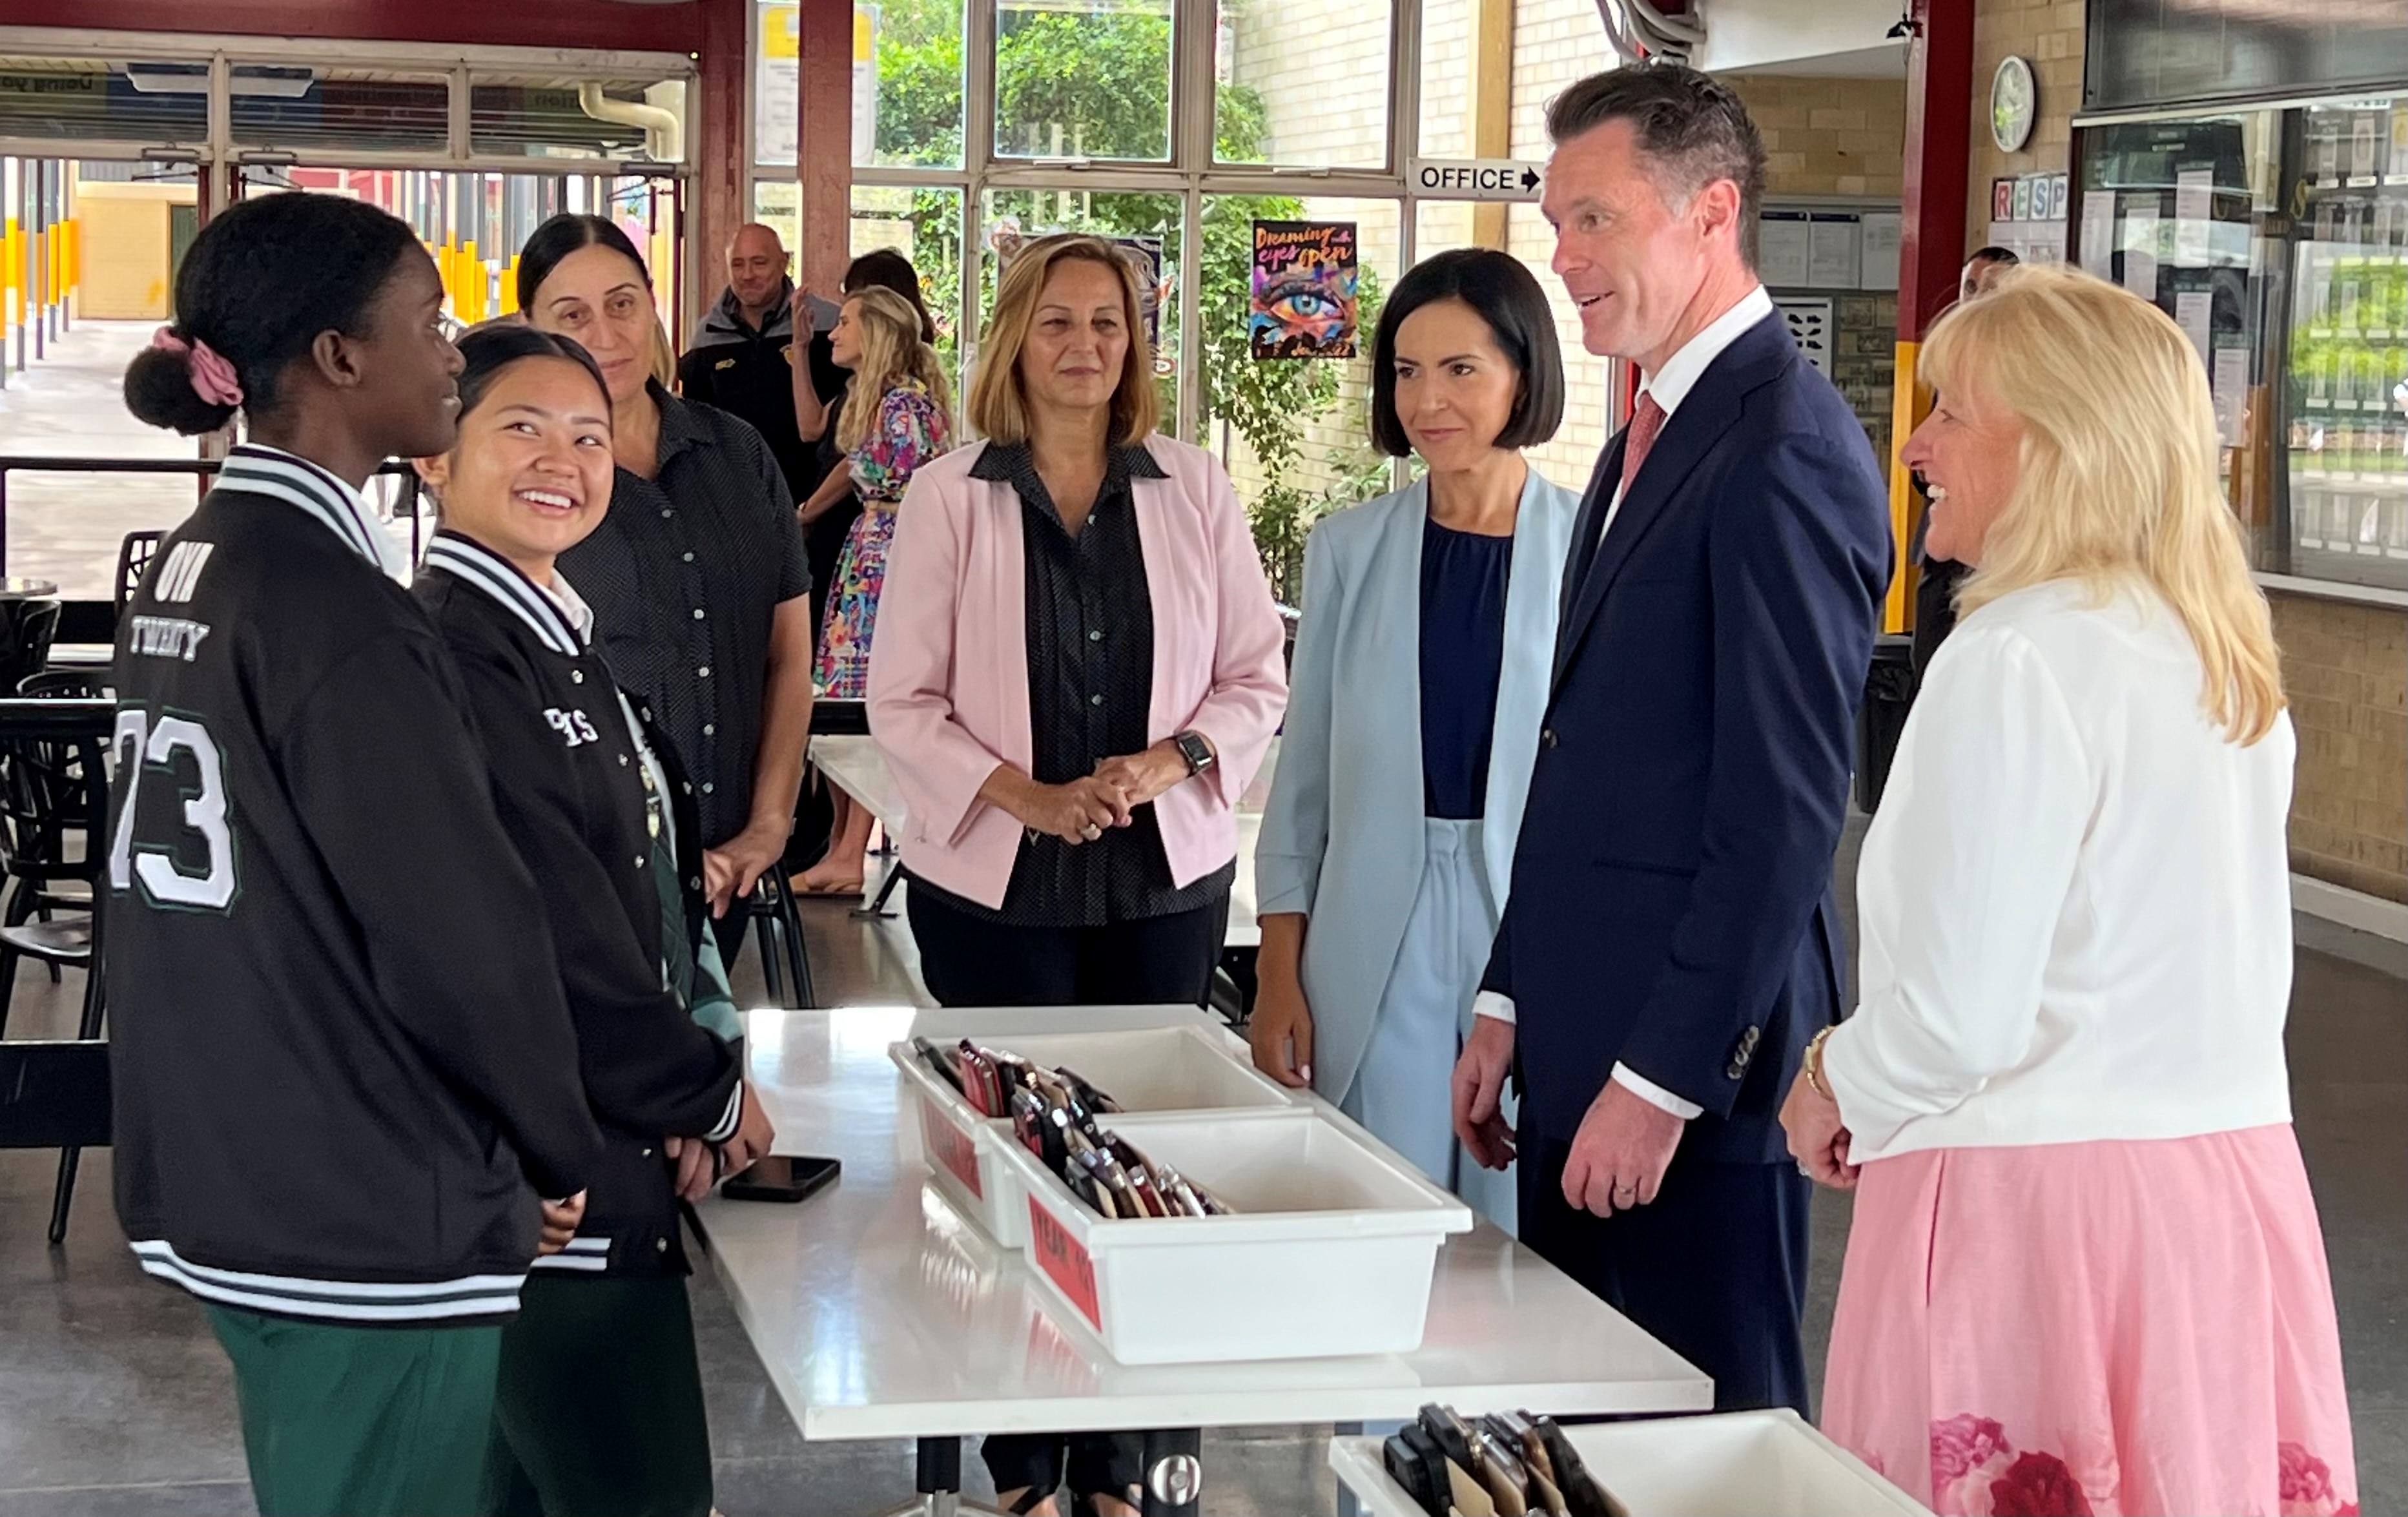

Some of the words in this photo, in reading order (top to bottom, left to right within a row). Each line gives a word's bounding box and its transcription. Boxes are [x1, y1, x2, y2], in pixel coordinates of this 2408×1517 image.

[1421, 167, 1514, 189] OFFICE
[1256, 227, 1336, 249] Dreaming
[1259, 245, 1301, 271] eyes
[1299, 245, 1353, 271] open
